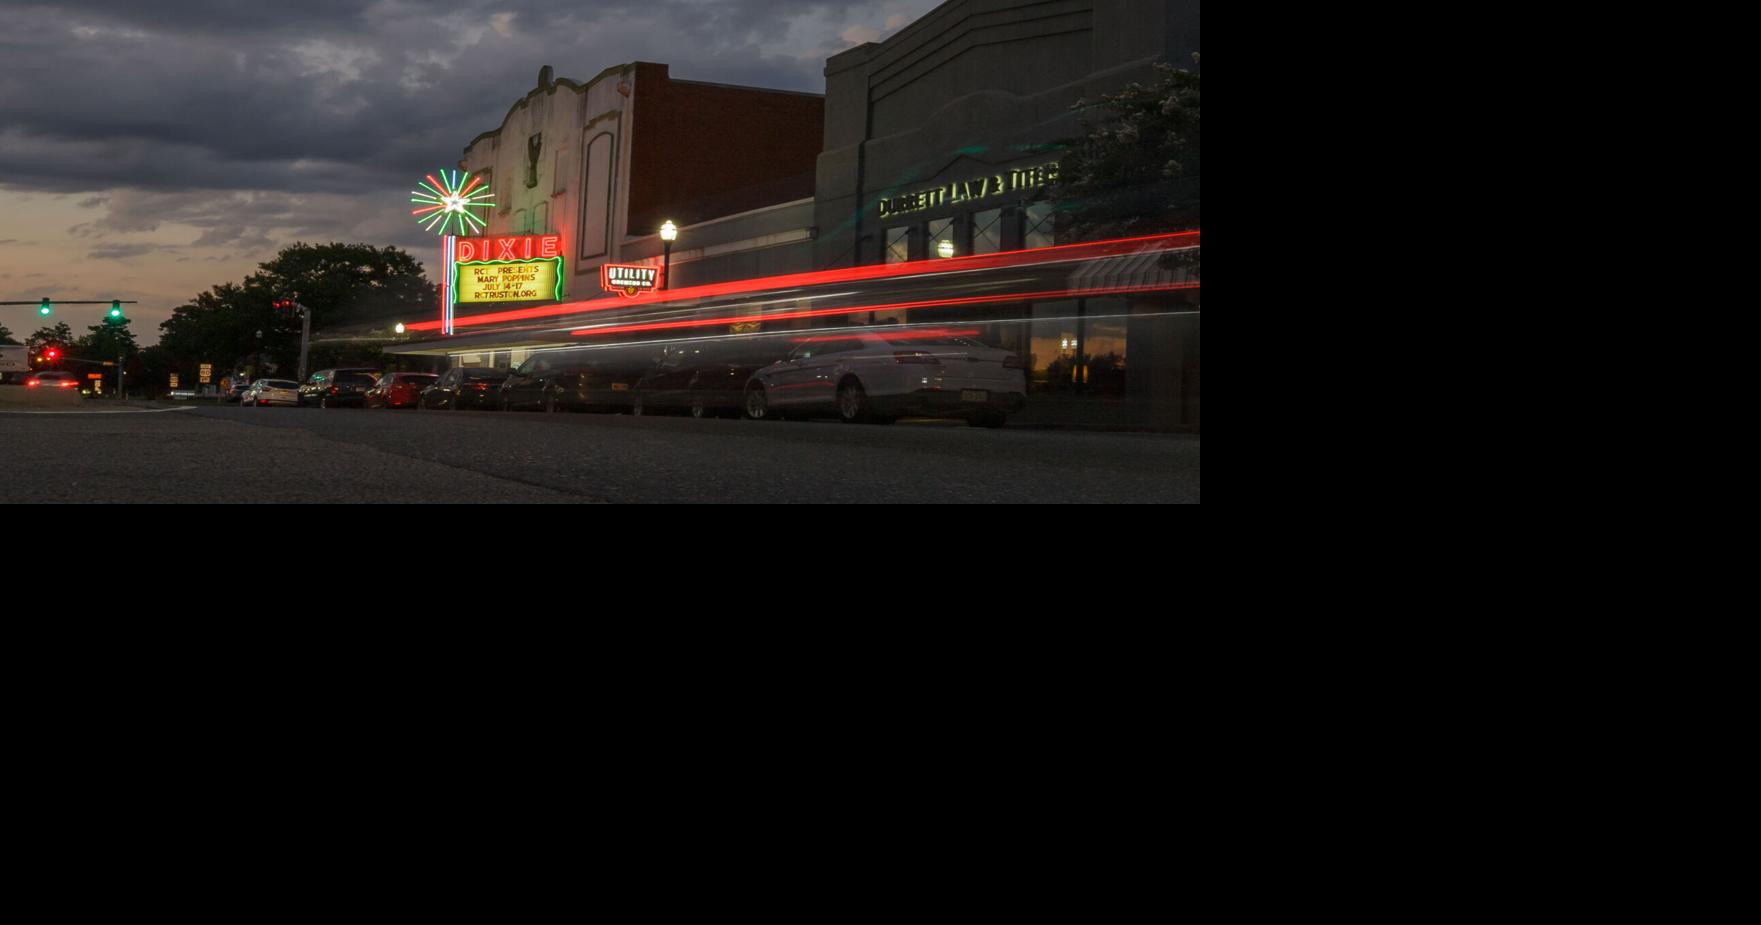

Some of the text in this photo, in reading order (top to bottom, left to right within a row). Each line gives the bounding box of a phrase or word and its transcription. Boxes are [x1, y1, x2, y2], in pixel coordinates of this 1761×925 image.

[879, 186, 947, 218] DURRETT
[950, 177, 988, 204] LAW
[992, 175, 1005, 196] &
[459, 236, 558, 262] DIXIE
[498, 265, 539, 274] PRESENTS
[609, 268, 655, 281] UTILITY
[502, 273, 536, 282] POPPINS
